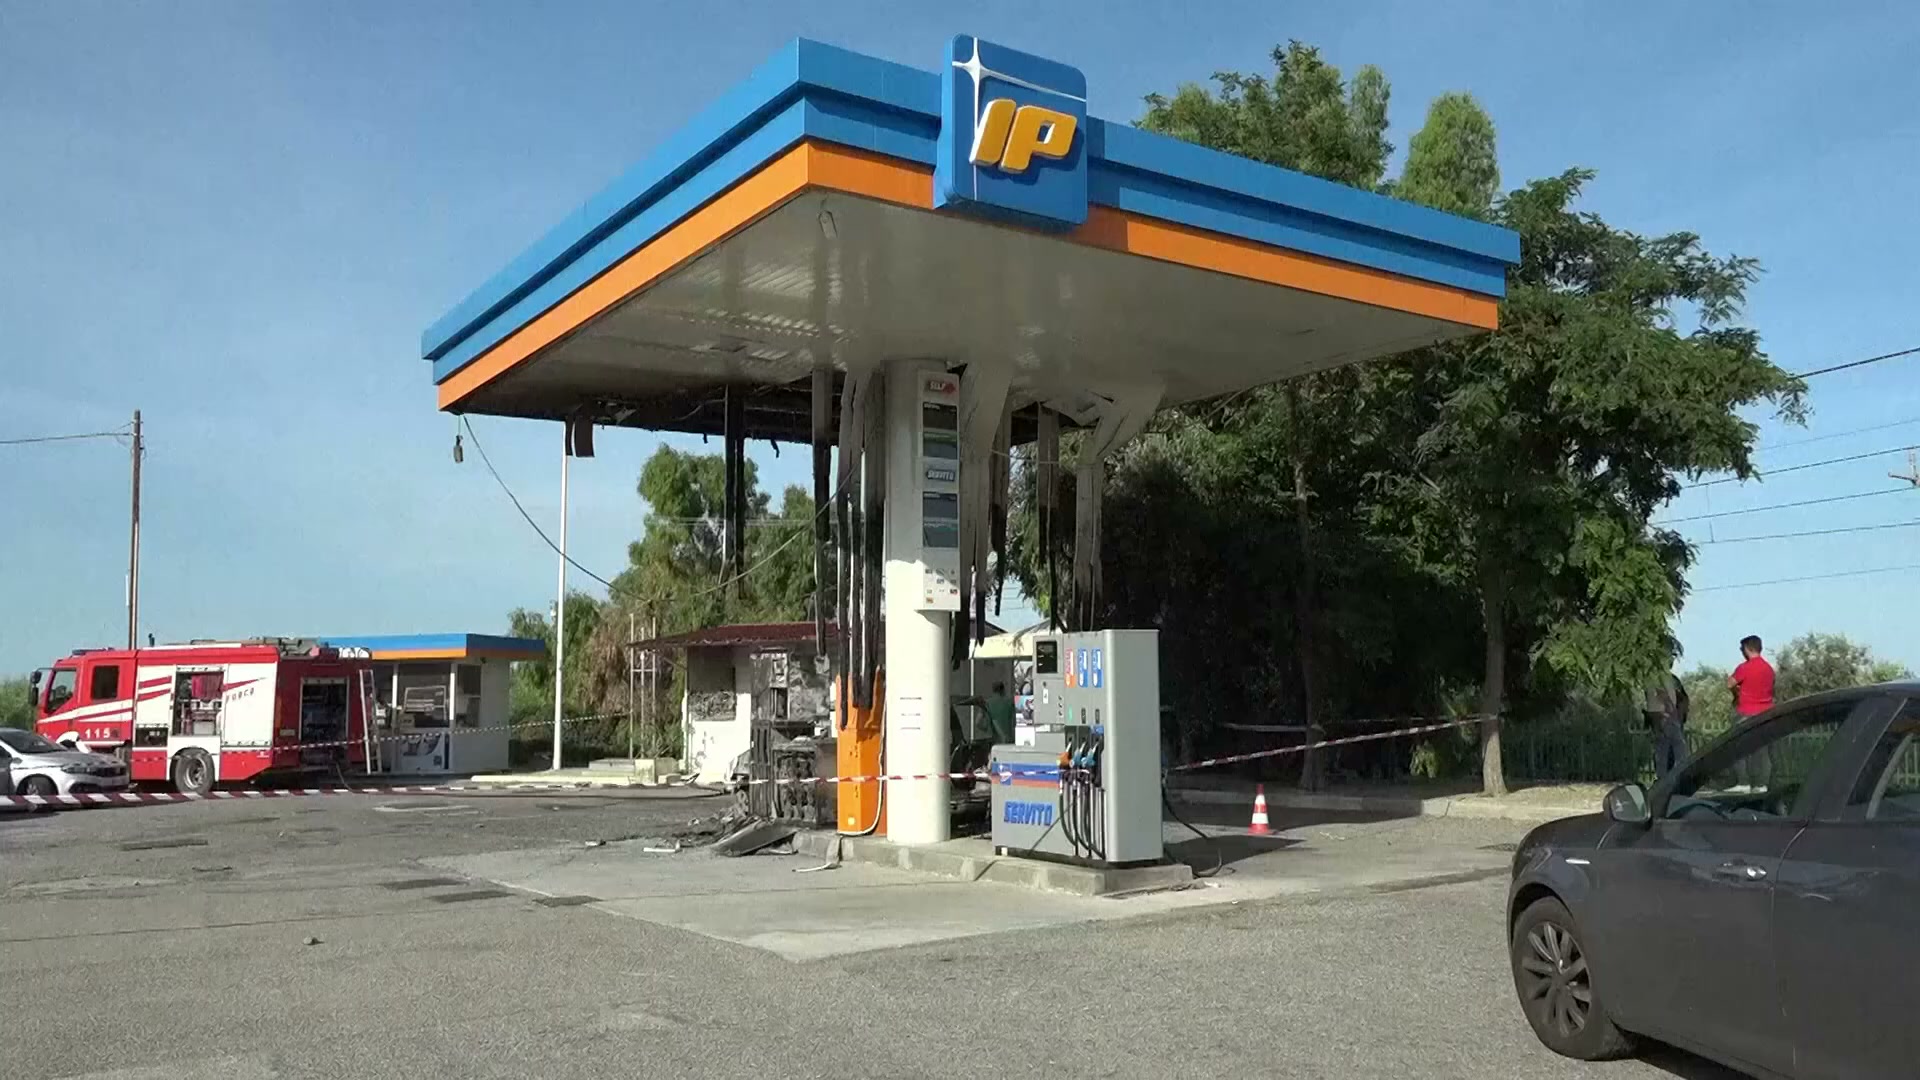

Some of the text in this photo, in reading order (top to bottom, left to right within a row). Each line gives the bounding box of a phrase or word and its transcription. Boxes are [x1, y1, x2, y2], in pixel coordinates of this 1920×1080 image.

[969, 98, 1078, 175] IP
[85, 727, 110, 739] 115
[1004, 800, 1052, 826] SERVITO
